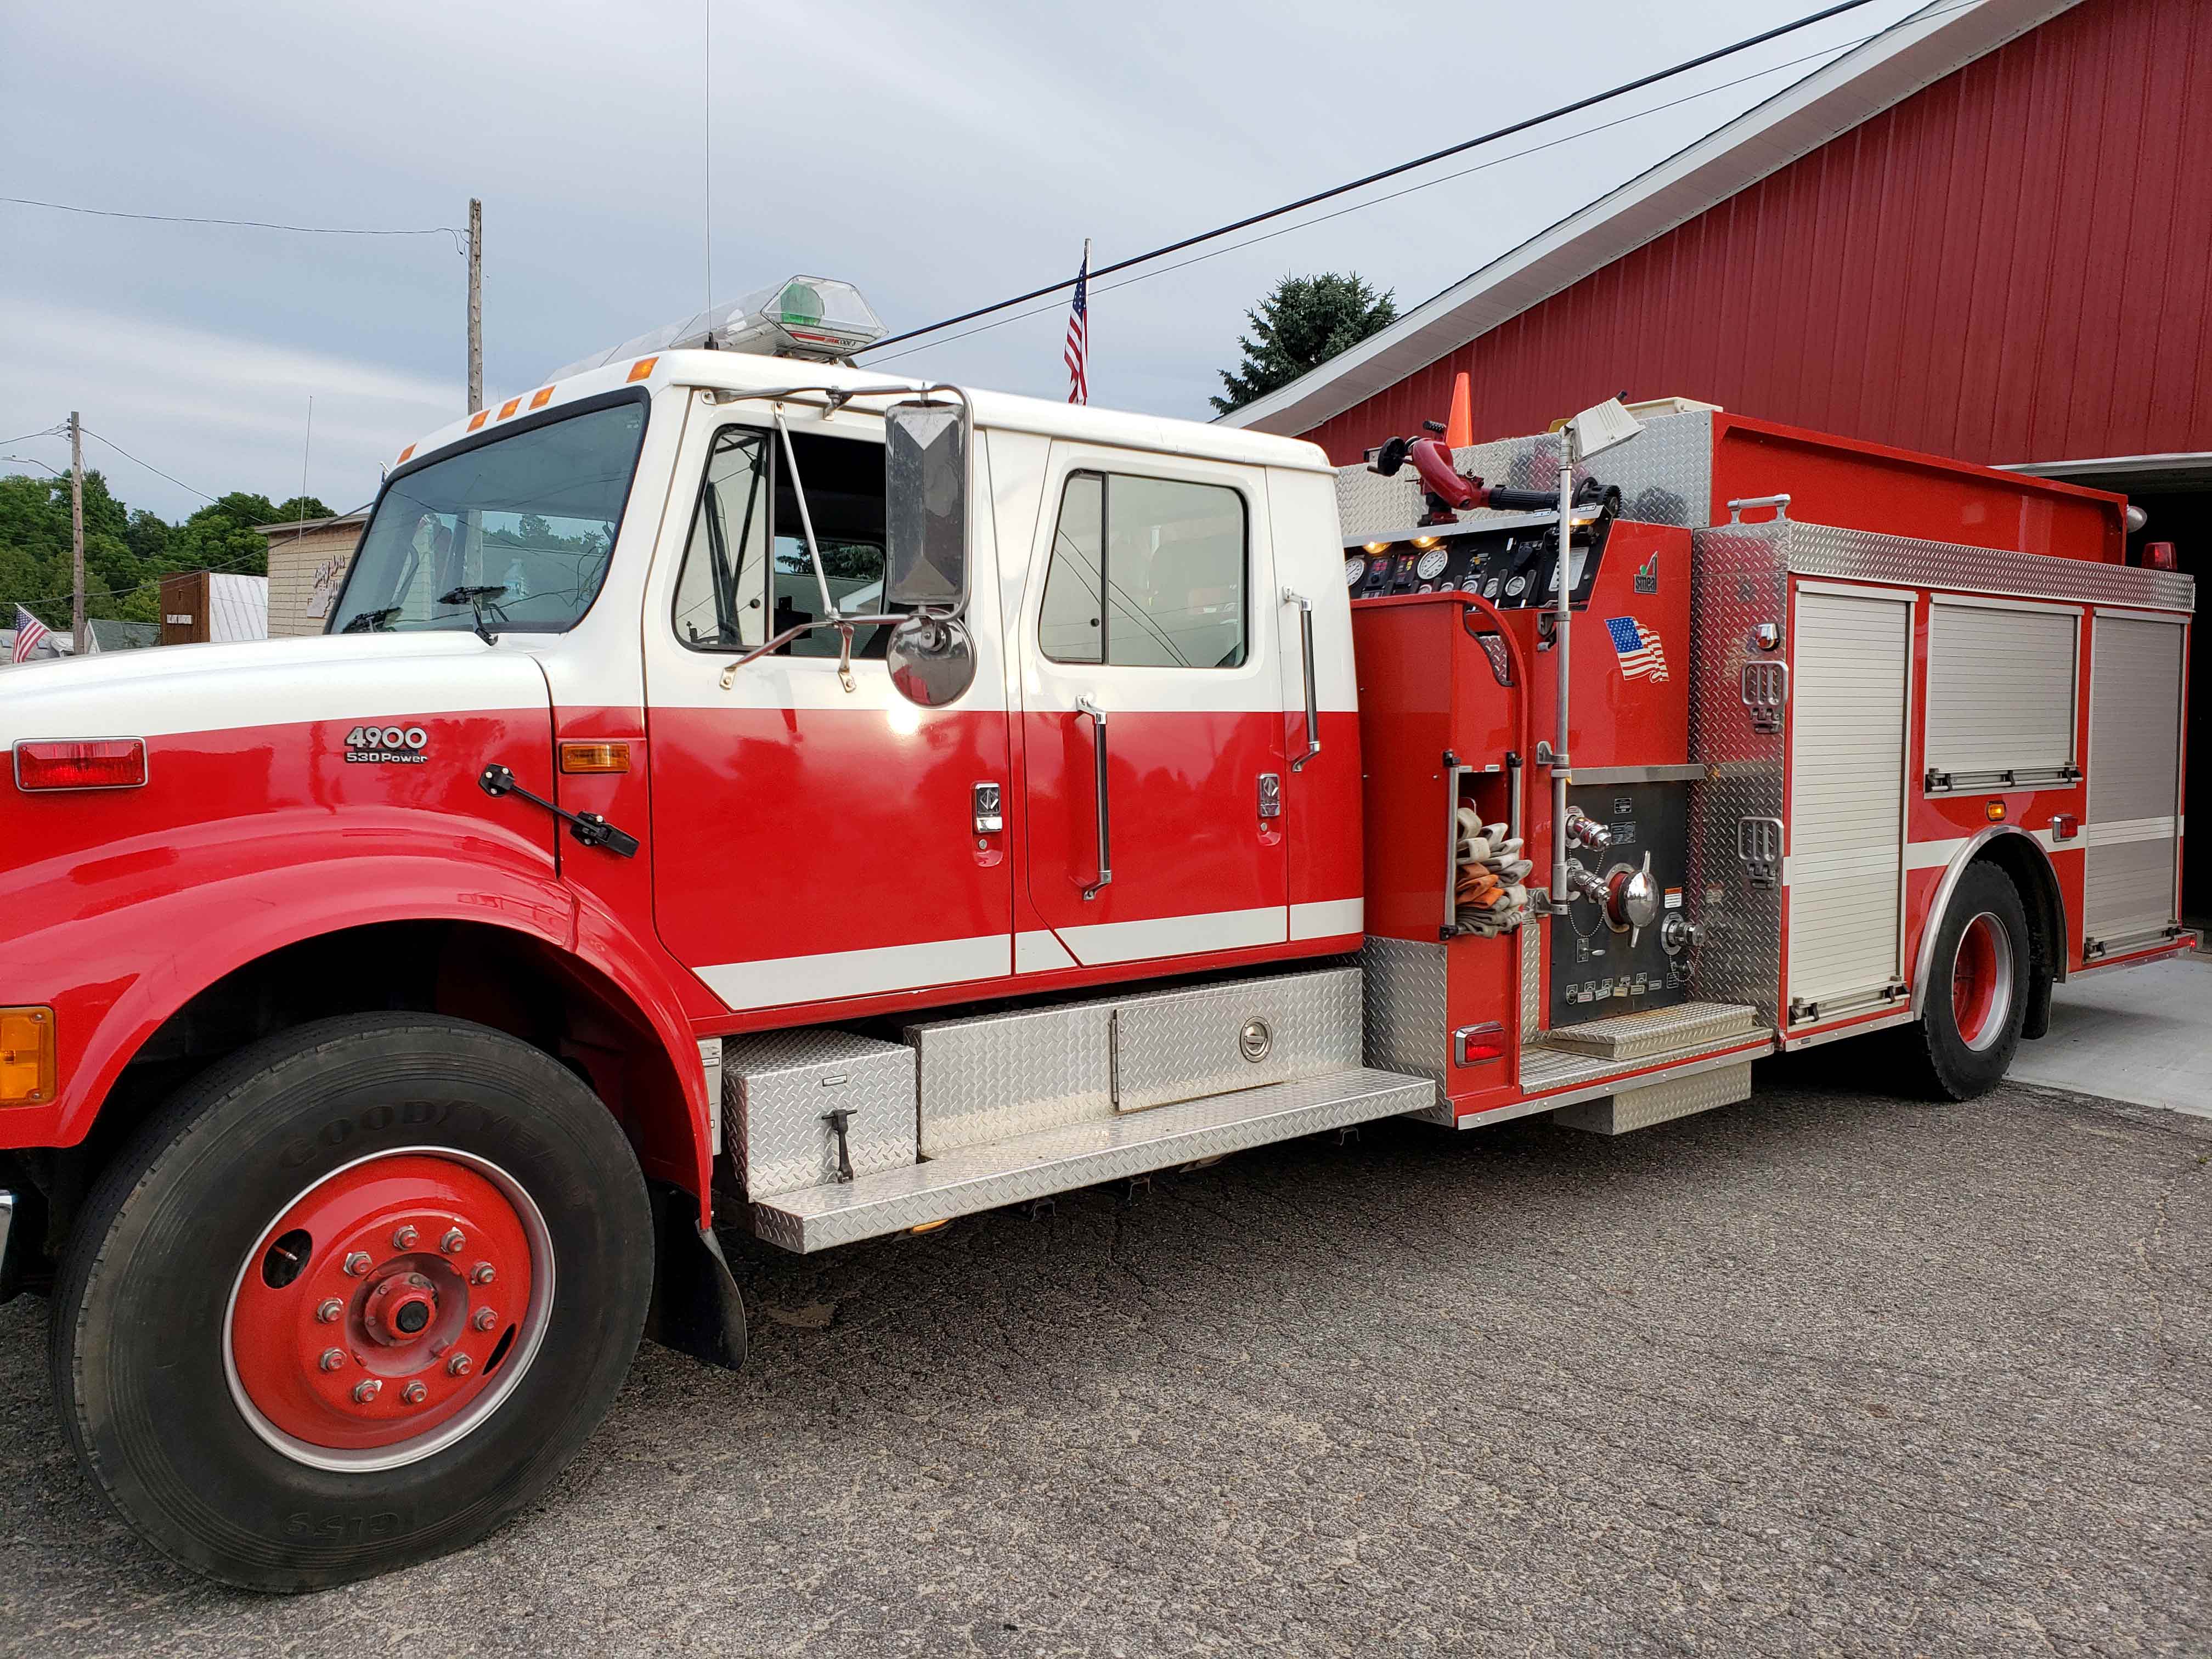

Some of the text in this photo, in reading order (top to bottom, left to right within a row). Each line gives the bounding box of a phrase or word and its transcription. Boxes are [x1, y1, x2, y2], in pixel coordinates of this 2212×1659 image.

[346, 726, 428, 749] 4900
[346, 752, 428, 763] 530 Power
[277, 1100, 590, 1210] GOODYEAR
